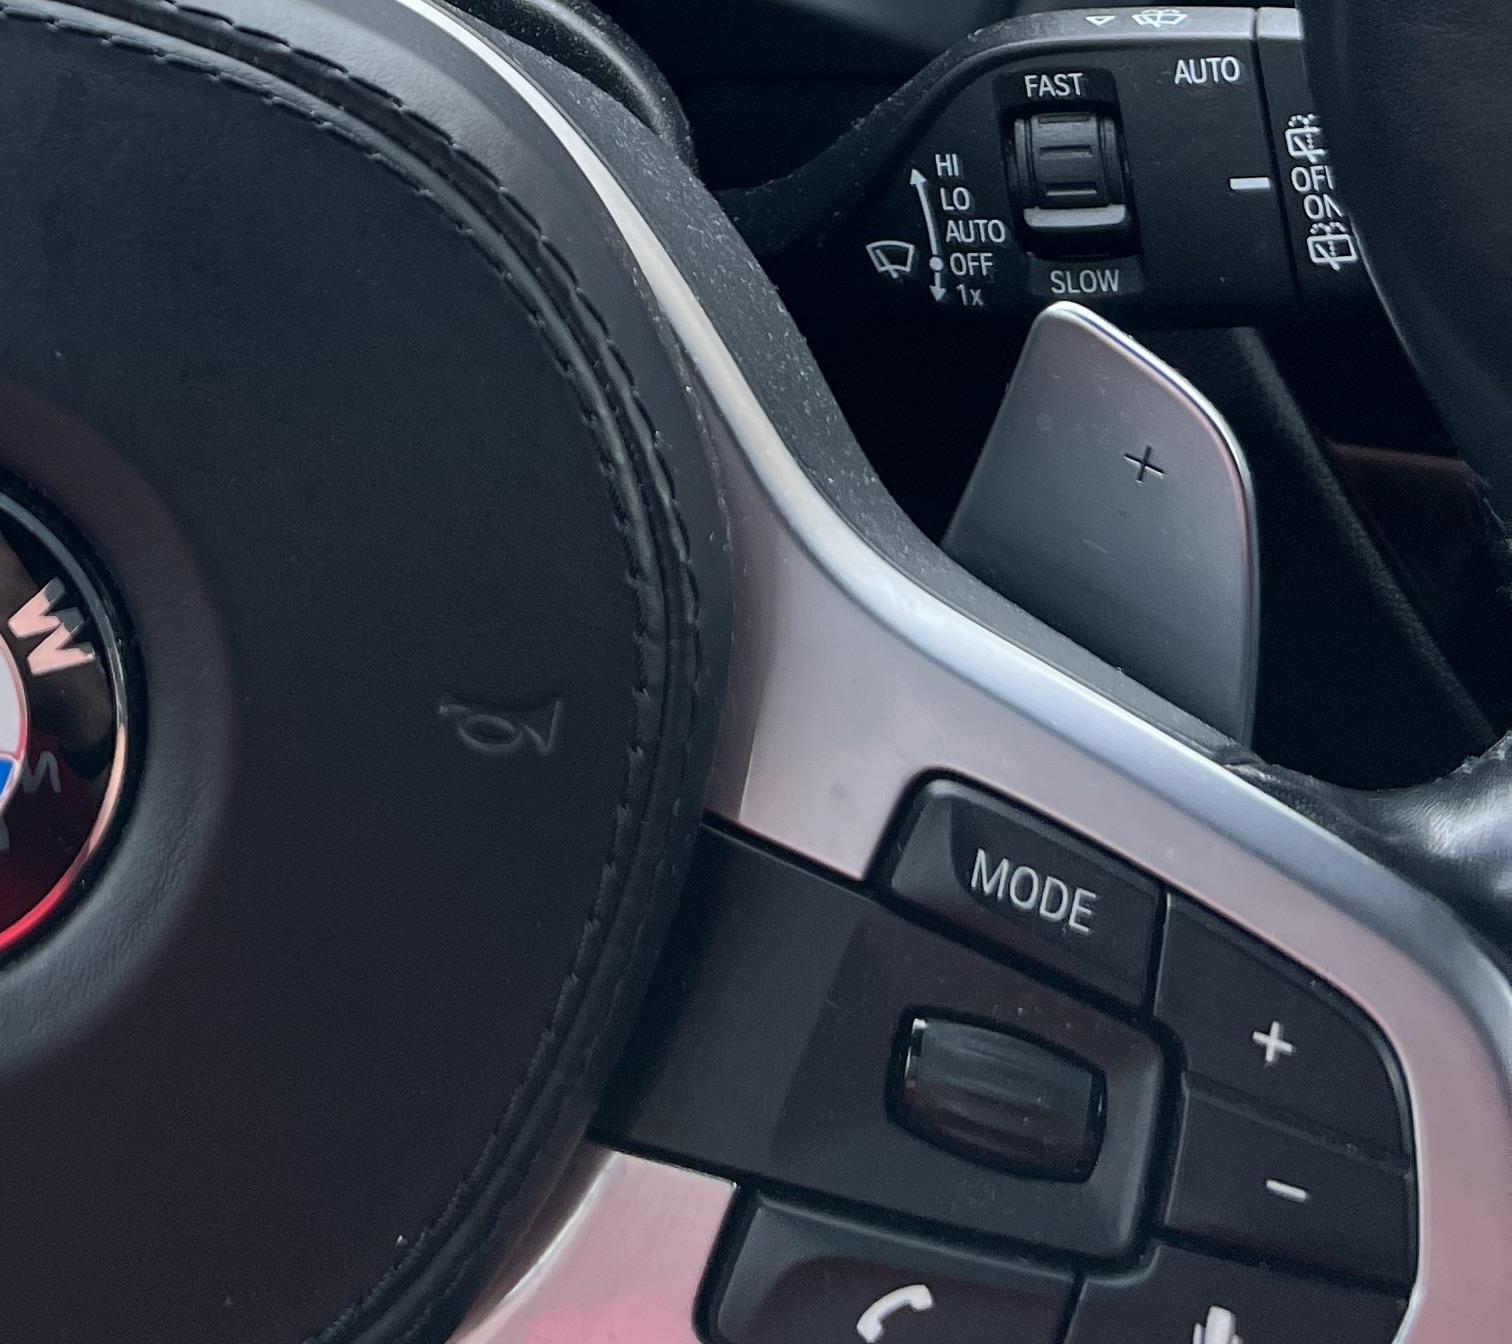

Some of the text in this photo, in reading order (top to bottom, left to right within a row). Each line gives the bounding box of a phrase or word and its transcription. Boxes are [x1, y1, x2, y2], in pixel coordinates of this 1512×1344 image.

[1174, 56, 1241, 84] AUTO
[1024, 72, 1083, 97] FAST
[935, 153, 959, 177] HI
[940, 186, 970, 211] LO
[945, 219, 1006, 244] AUTO
[949, 252, 993, 276] OFF
[955, 283, 984, 306] 1x
[1050, 269, 1120, 295] SLOW
[971, 848, 1096, 934] MODE
